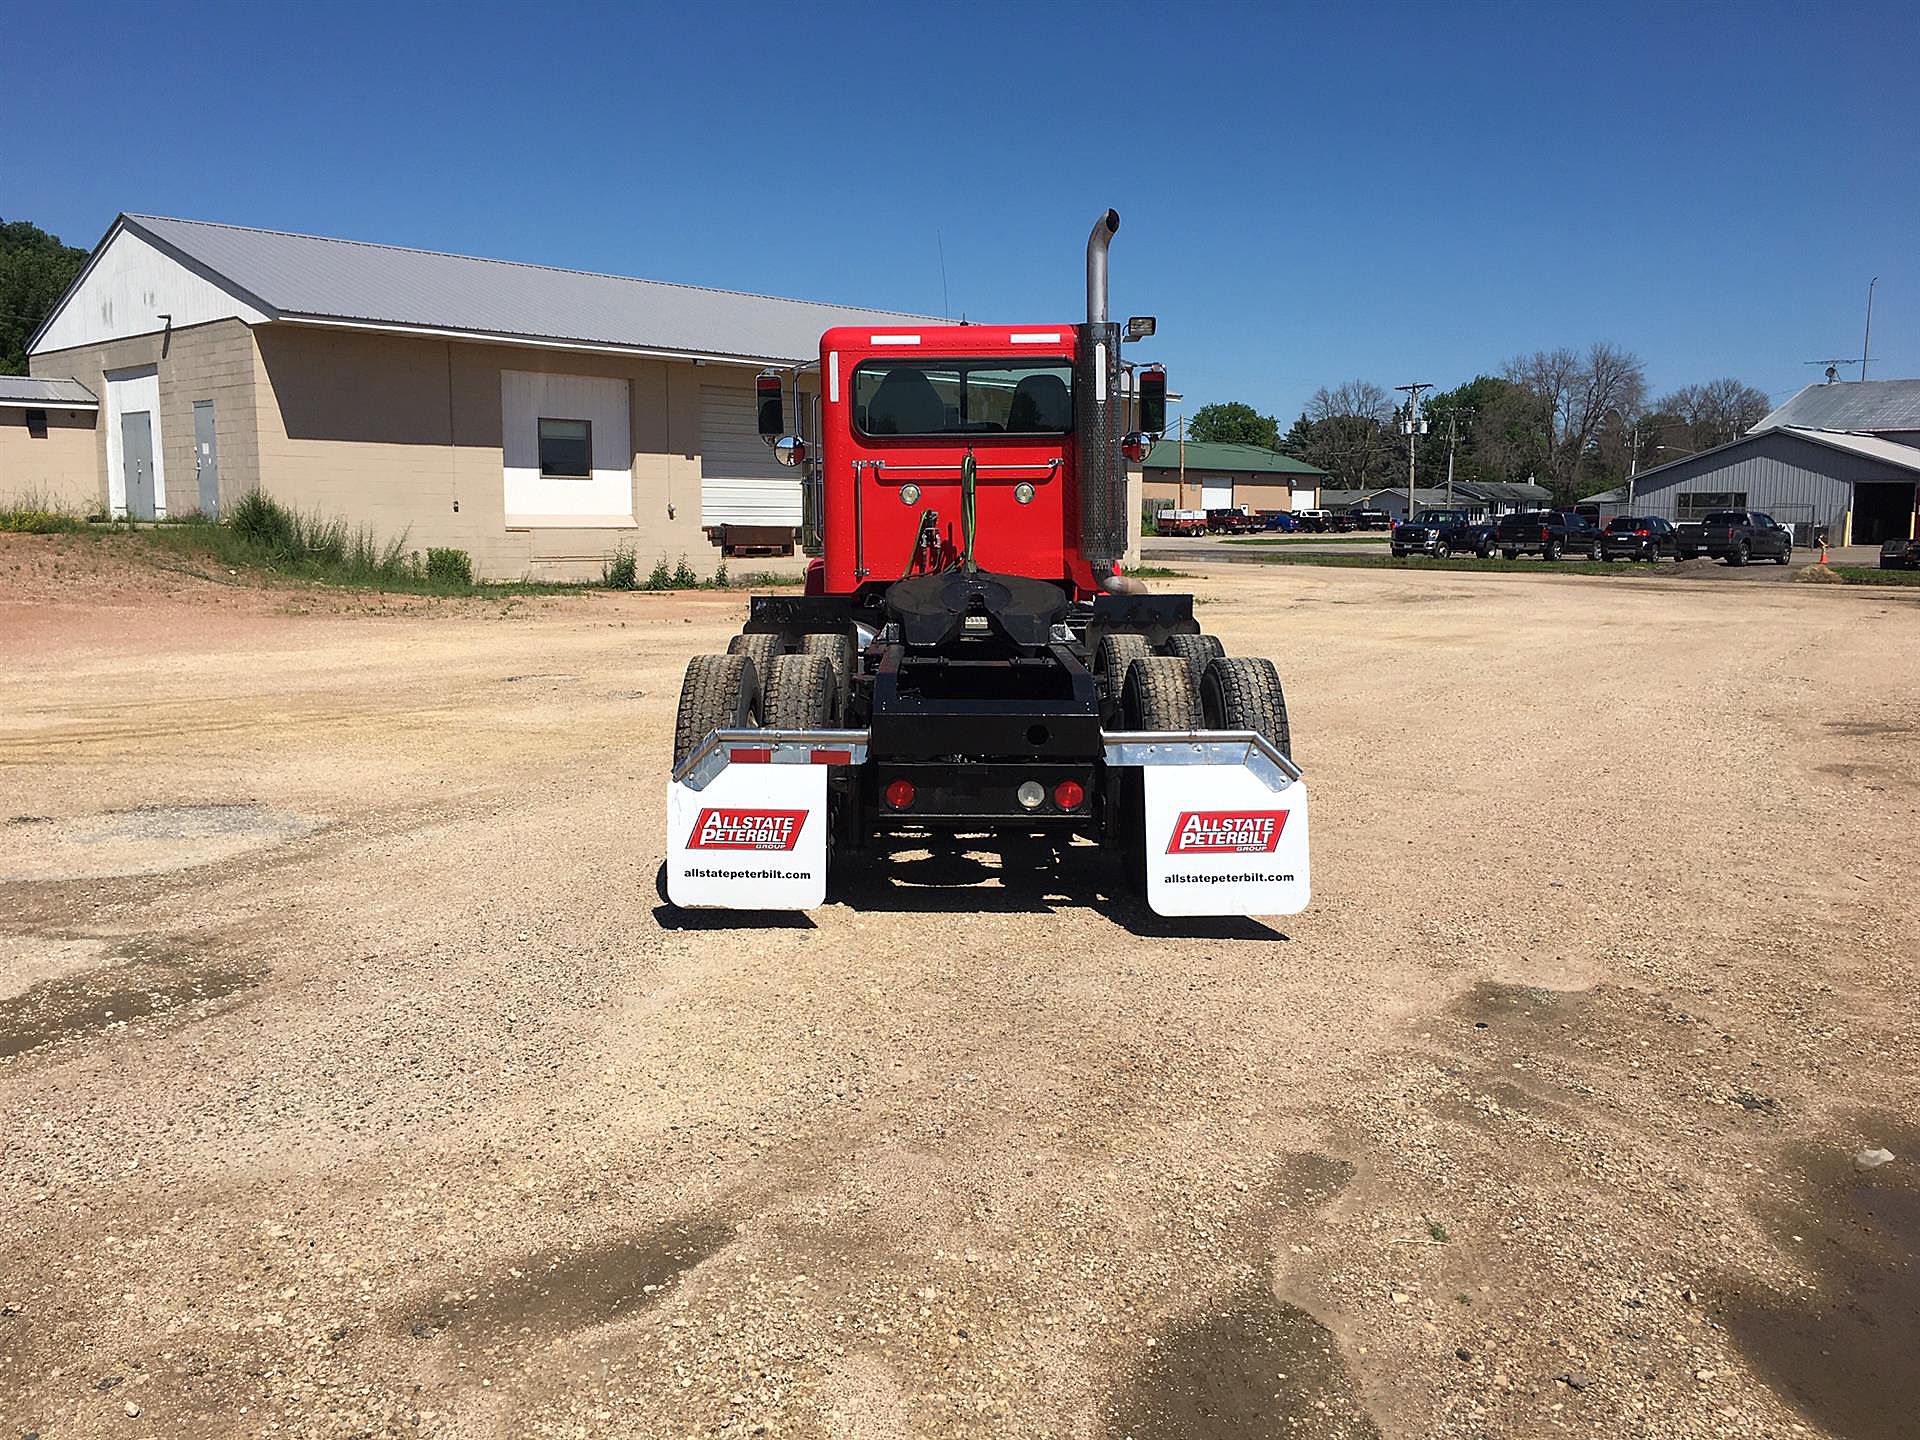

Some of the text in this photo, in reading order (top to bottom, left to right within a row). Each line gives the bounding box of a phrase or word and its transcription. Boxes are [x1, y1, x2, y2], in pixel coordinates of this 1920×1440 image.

[704, 811, 795, 829] ALLSTATE
[1183, 814, 1275, 832] ALLSTATE
[700, 829, 792, 846] PETERBILT
[1179, 831, 1273, 849] PETERBILT
[684, 868, 811, 880] allstatepeterbilt.com
[1164, 873, 1295, 884] allstatepeterbilt.com
